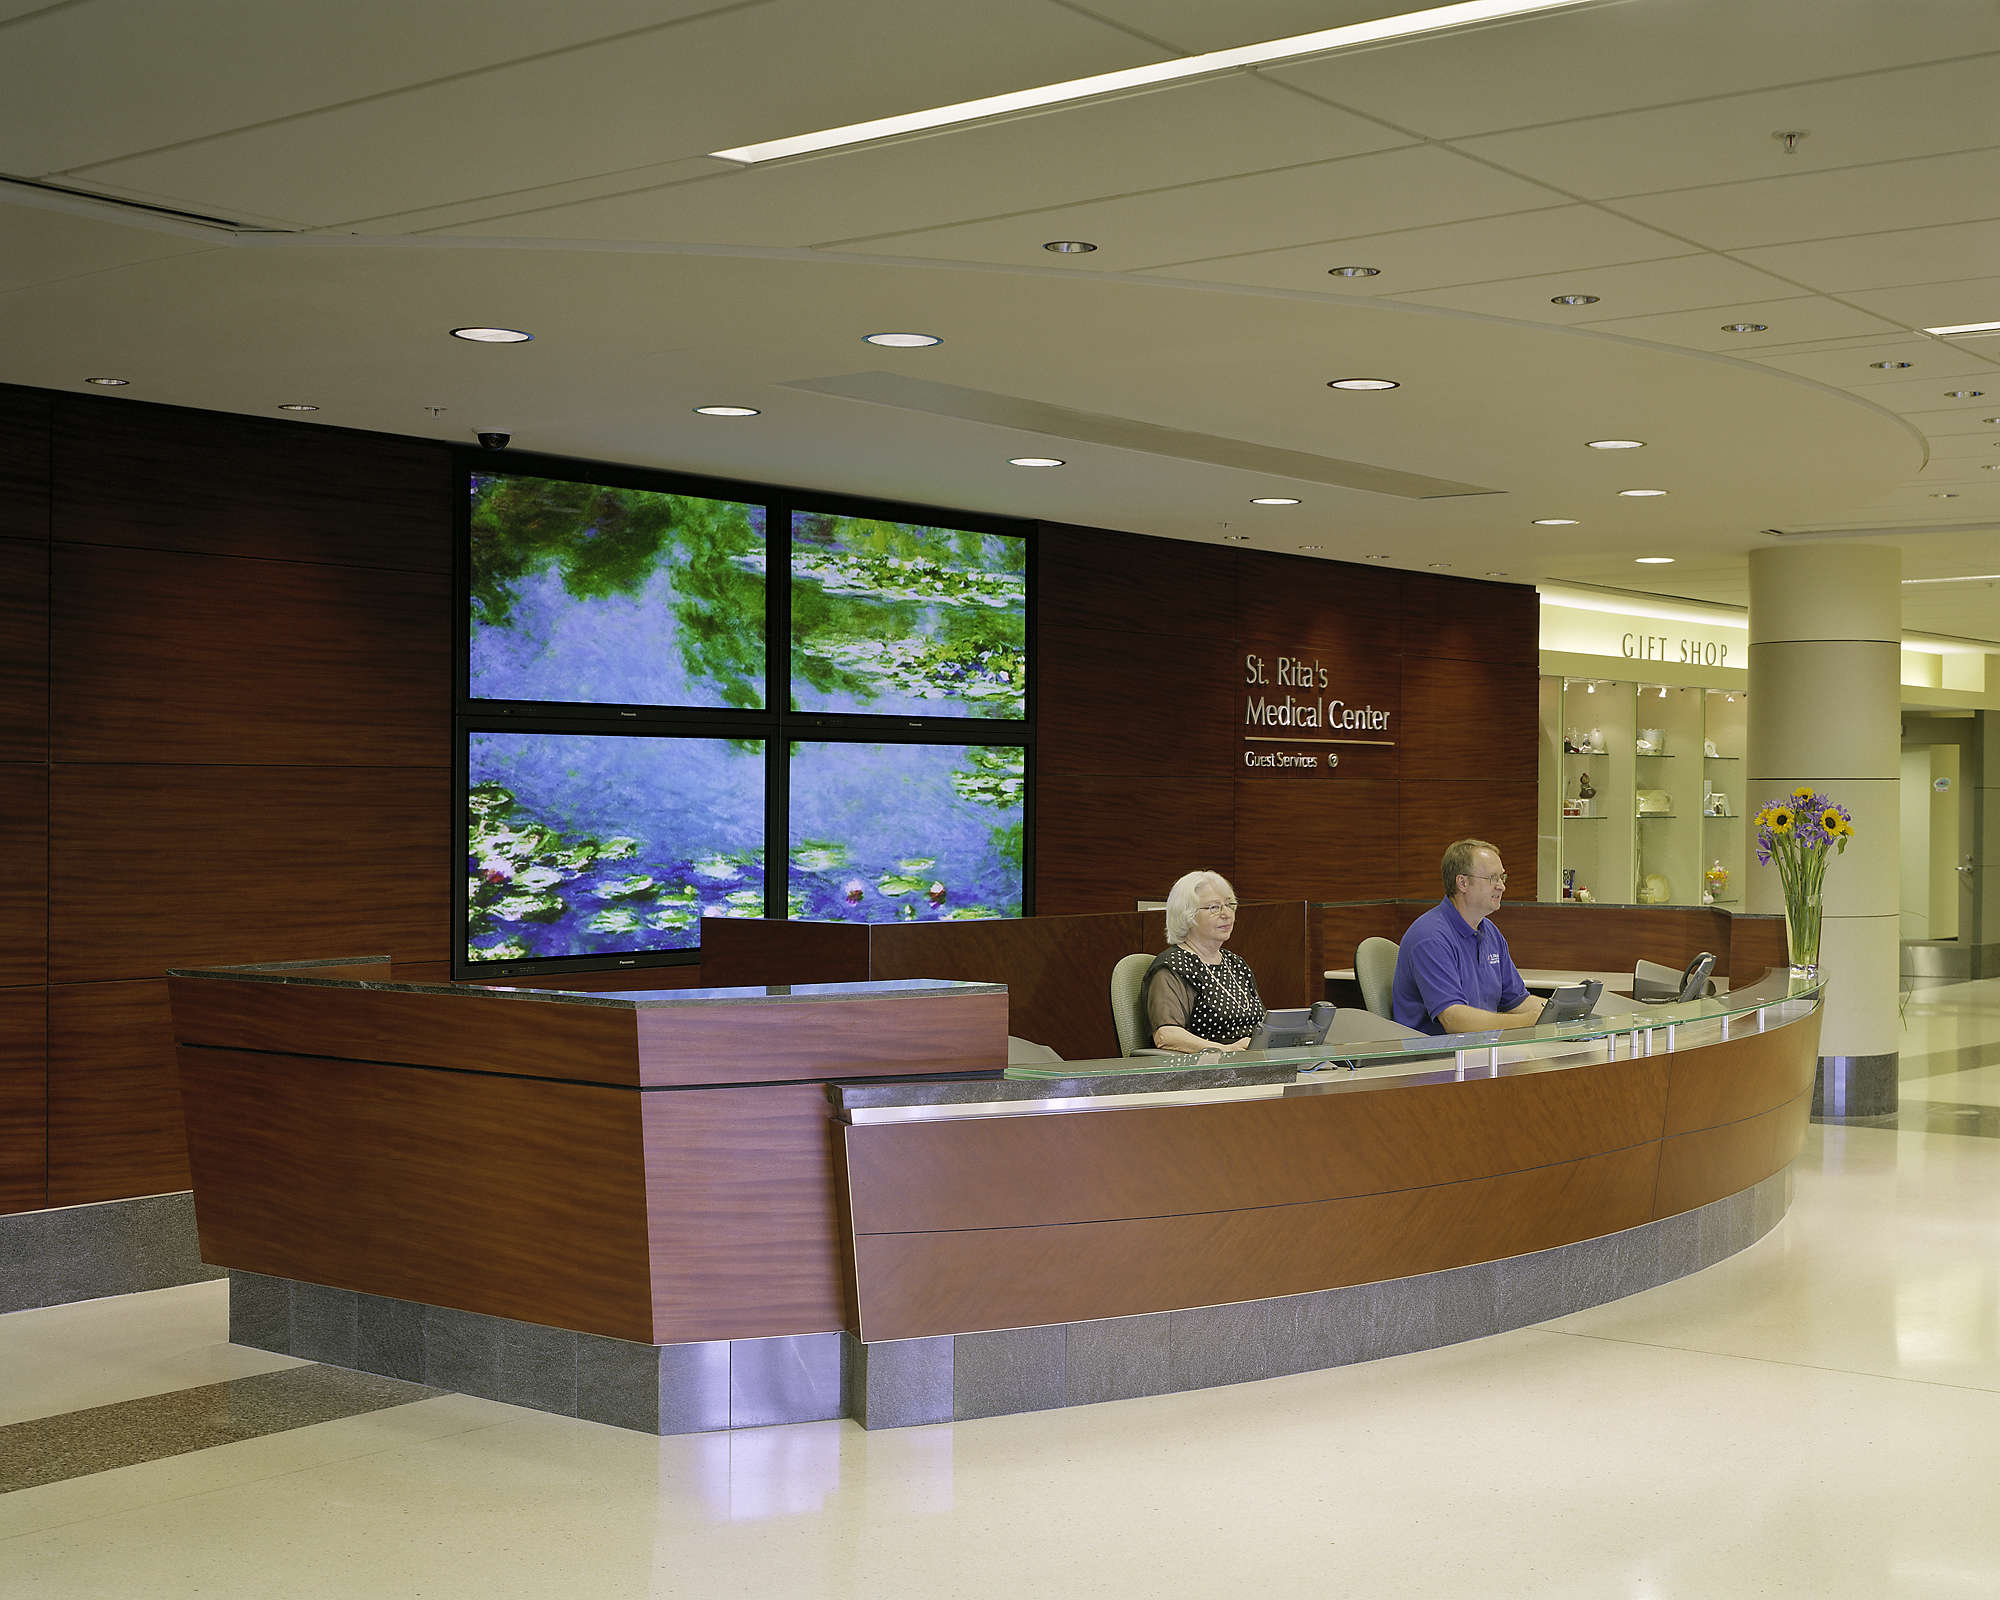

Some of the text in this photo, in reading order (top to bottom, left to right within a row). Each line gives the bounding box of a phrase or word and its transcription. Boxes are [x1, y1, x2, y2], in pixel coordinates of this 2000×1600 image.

[1622, 632, 1728, 667] GIFT SHOP
[1245, 654, 1329, 689] St. Rita's
[1245, 695, 1391, 730] Medical Center
[1245, 751, 1318, 768] Guest Services
